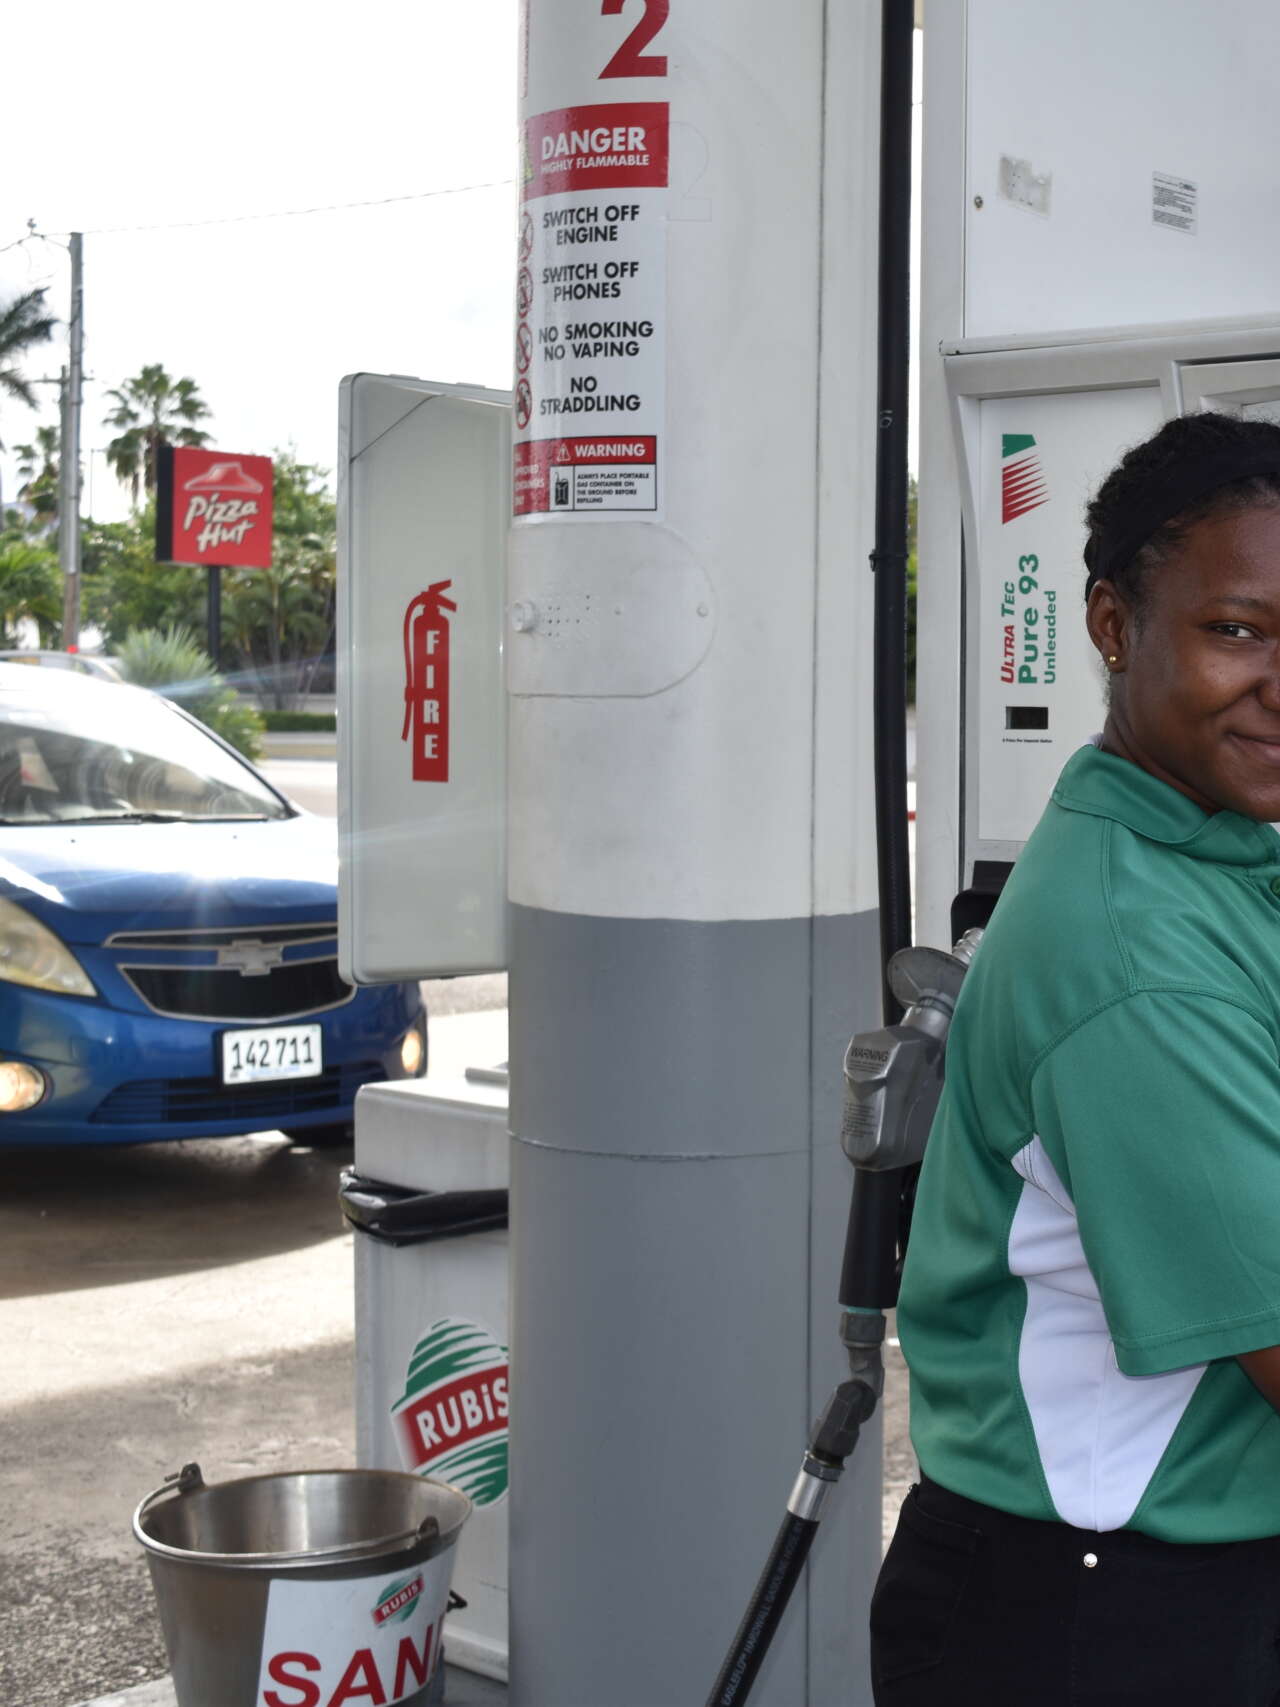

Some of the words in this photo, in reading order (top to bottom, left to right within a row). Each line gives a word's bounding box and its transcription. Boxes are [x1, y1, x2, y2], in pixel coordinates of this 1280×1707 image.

[598, 0, 670, 79] 2
[541, 127, 647, 161] DANGER
[541, 158, 573, 174] HIGHLY
[576, 154, 650, 169] FLAMMABLE
[543, 207, 598, 229] SWITCH
[604, 205, 640, 222] OFF
[556, 225, 618, 246] ENGINE
[542, 263, 598, 285] SWITCH
[603, 262, 639, 279] OFF
[553, 282, 621, 302] PHONES
[538, 326, 559, 346] NO
[564, 321, 654, 341] SMOKING
[544, 344, 566, 362] NO
[572, 341, 640, 359] VAPING
[570, 376, 597, 394] NO
[540, 394, 641, 416] STRADDLING
[574, 443, 646, 458] WARNING
[183, 492, 258, 531] Pizza
[196, 520, 254, 552] Hut
[1018, 554, 1039, 595] 93
[1001, 581, 1015, 617] TEC
[1018, 607, 1039, 684] Pure
[1044, 590, 1056, 684] Unleaded
[1001, 624, 1015, 684] ULTRA
[423, 630, 440, 758] FIRE
[851, 1047, 889, 1062] WARNING
